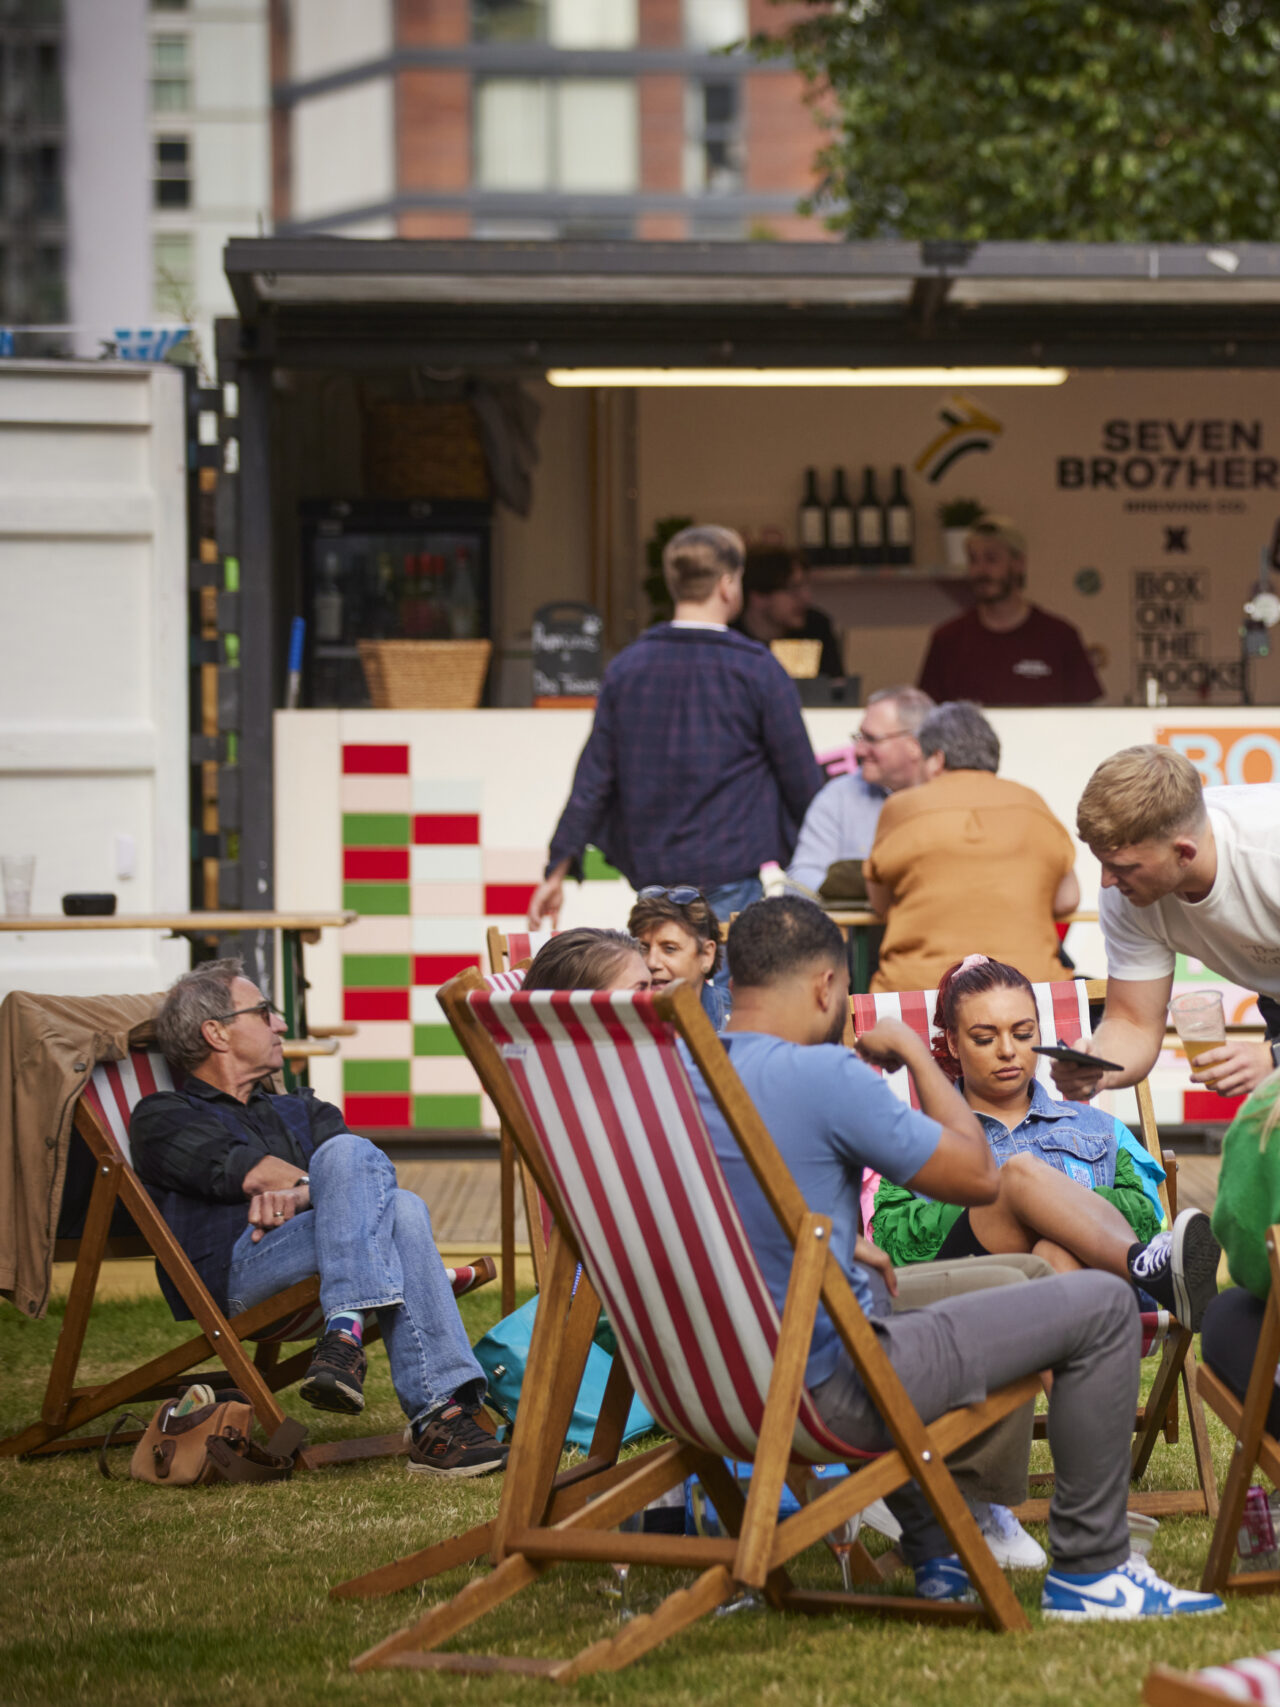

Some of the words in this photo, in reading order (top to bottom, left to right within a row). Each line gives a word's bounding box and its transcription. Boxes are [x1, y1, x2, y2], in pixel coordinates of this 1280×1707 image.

[1103, 419, 1262, 453] SEVEN
[1134, 571, 1203, 600] BOX
[1135, 602, 1183, 630] ON
[1136, 632, 1200, 660] THE
